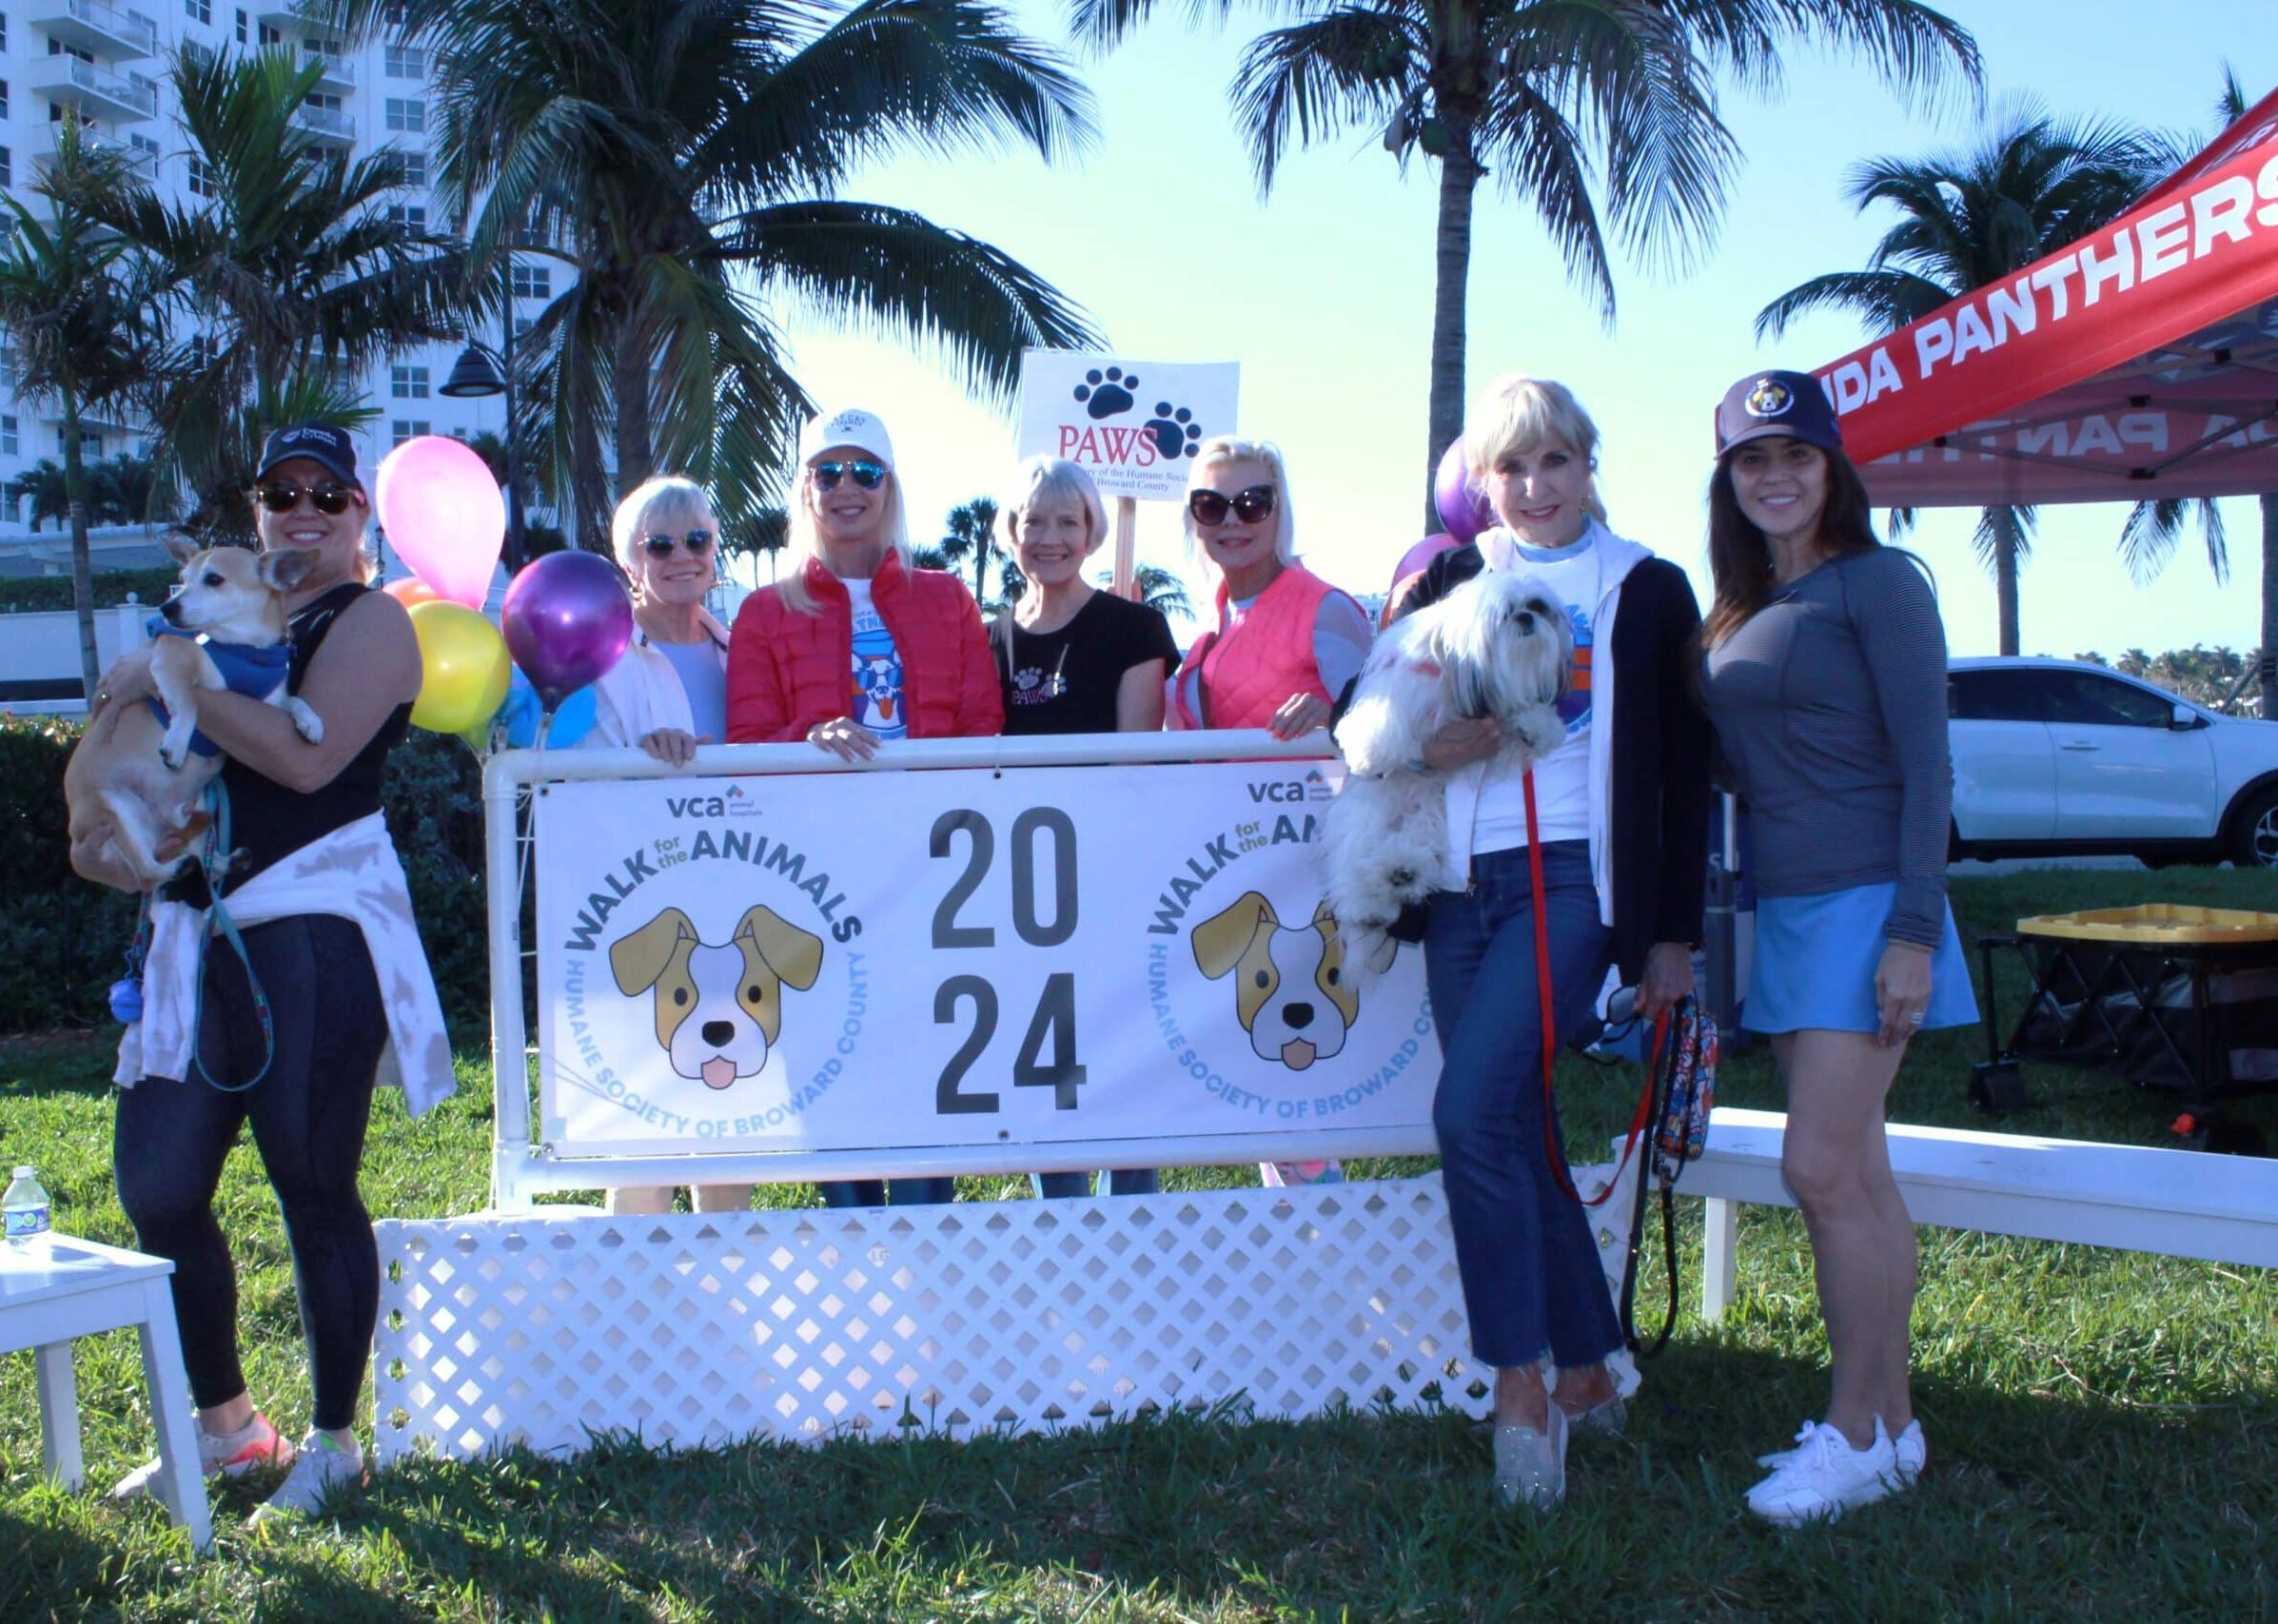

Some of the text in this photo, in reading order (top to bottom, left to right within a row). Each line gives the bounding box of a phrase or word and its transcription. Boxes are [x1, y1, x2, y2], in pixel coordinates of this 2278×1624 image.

[1058, 424, 1157, 467] PAWS
[1097, 478, 1169, 492] Broward County
[1110, 468, 1124, 478] the
[1127, 469, 1164, 480] Humane
[1011, 690, 1048, 705] PAWS
[667, 796, 724, 818] vca
[1247, 781, 1305, 803] vca
[1234, 821, 1261, 838] for
[1238, 835, 1268, 853] the
[564, 829, 863, 950] WALK for the ANIMALS
[930, 806, 1079, 949] 20
[1148, 832, 1240, 937] WALK
[564, 950, 868, 1140] HUMANE SOCIETY OF BROWARD COUNTY
[933, 971, 1088, 1115] 24
[1148, 942, 1187, 1052] HUMANE
[1178, 1049, 1272, 1115] SOCIETY
[1276, 1100, 1309, 1120] OF
[1314, 1039, 1421, 1117] BROWARD
